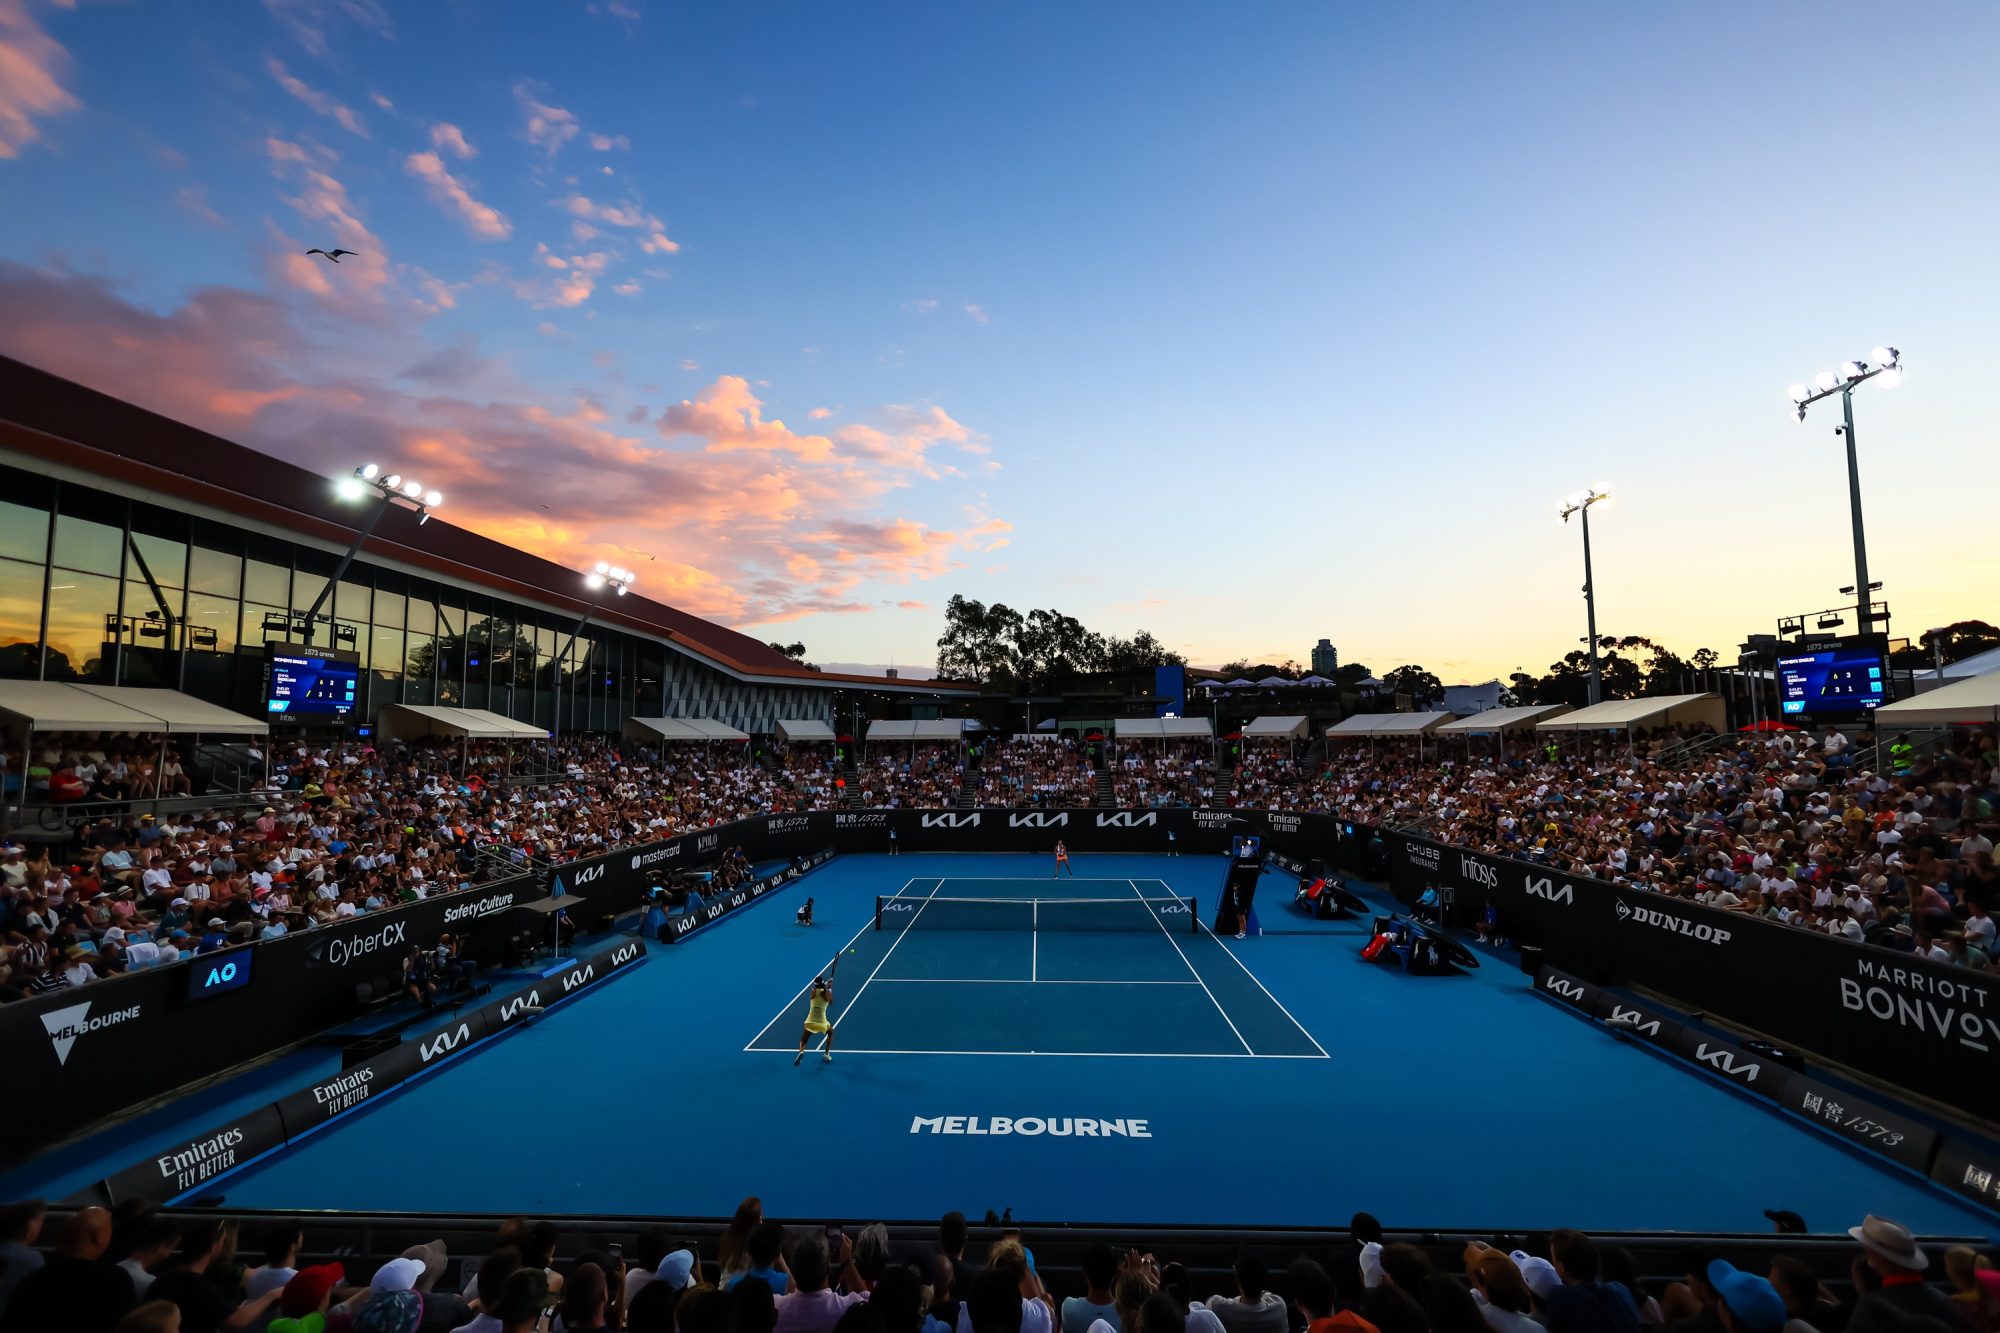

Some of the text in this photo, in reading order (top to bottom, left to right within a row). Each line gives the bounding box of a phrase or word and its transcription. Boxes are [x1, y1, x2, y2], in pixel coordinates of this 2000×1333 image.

[304, 648, 318, 656] 1573
[1806, 643, 1822, 652] 1573
[1788, 703, 1800, 711] AO
[784, 817, 809, 827] 1573
[857, 814, 887, 822] 1573
[922, 812, 980, 827] KIA
[1010, 812, 1068, 827] KIA
[1096, 812, 1156, 827] KIA
[1192, 811, 1232, 820] Emirates
[1268, 814, 1301, 825] Emirates
[1282, 824, 1297, 832] BETTER
[702, 833, 718, 848] POLO
[1407, 842, 1440, 860] CHUBB
[642, 842, 680, 865] mastercard
[1410, 855, 1438, 870] INSURANCE
[575, 864, 604, 885] KIA
[771, 874, 782, 887] KIA
[1461, 853, 1498, 889] Infosys
[732, 892, 746, 906] KIA
[752, 882, 765, 895] KIA
[1525, 874, 1573, 906] KIA
[444, 892, 514, 923] SafetyCulture
[707, 902, 724, 919] KIA
[884, 904, 912, 912] KIA
[677, 916, 696, 933] KIA
[1632, 906, 1731, 945] DUNLOP
[329, 921, 406, 967] CyberCX
[612, 943, 637, 966] KIA
[205, 962, 236, 987] AO
[563, 964, 594, 991] KIA
[1858, 959, 1988, 1008] MARRIOTT
[1546, 975, 1584, 1000] KIA
[501, 990, 539, 1022] KIA
[50, 1005, 140, 1041] MELBOURNE
[1611, 1005, 1661, 1036] KIA
[420, 1023, 470, 1062] KIA
[1695, 1042, 1760, 1082] KIA
[312, 1067, 373, 1104] Emirates
[329, 1084, 369, 1115] FLY BETTER
[910, 1116, 1152, 1138] MELBOURNE
[1802, 1091, 1904, 1146] 國窖 1573
[158, 1127, 243, 1178] Emirates
[178, 1150, 235, 1190] FLY BETTER
